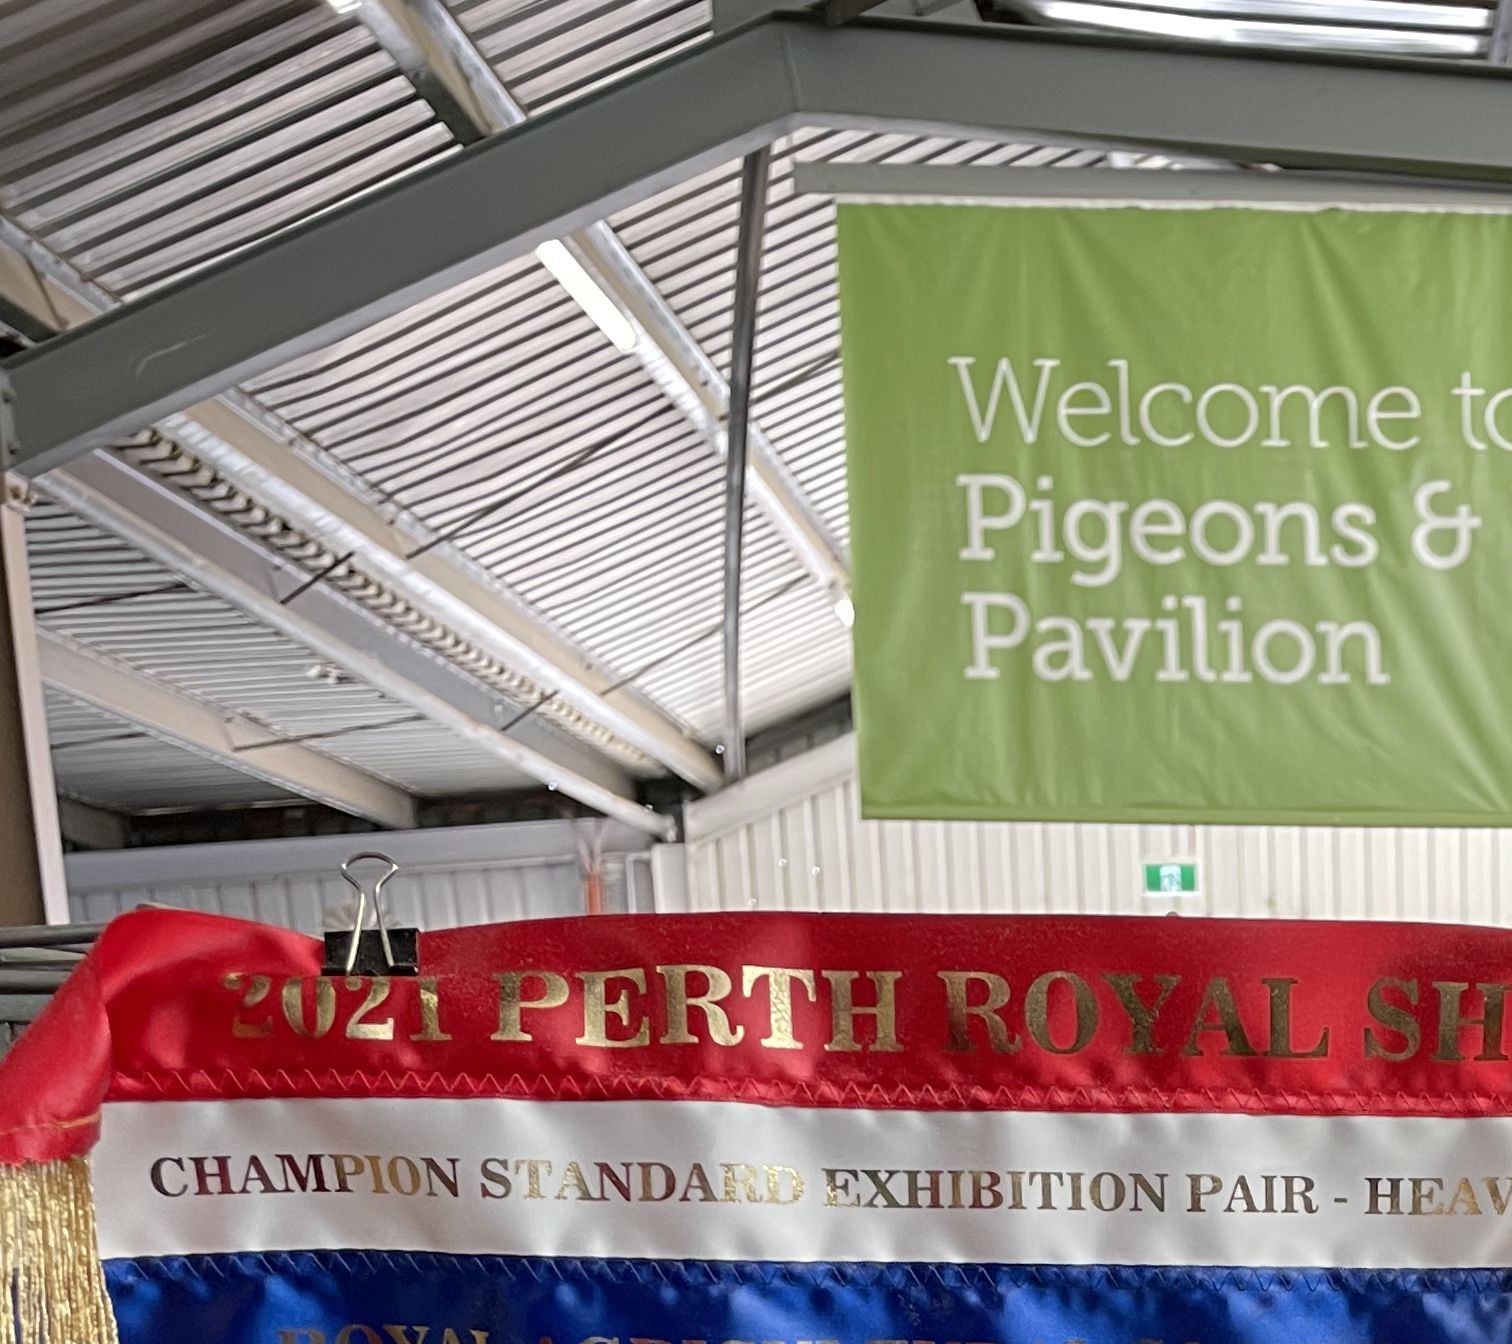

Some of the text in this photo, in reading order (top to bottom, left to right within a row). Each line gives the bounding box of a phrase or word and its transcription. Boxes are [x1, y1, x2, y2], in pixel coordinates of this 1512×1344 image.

[947, 355, 1422, 449] Welcome
[955, 473, 1381, 588] Pigeons
[1410, 480, 1483, 572] &
[960, 591, 1391, 687] Pavilion
[221, 971, 453, 1041] 2021
[489, 963, 906, 1053] PERTH
[938, 969, 1332, 1060] ROYAL
[149, 1151, 460, 1198] CHAMPION
[480, 1156, 806, 1207] STANDARD
[822, 1167, 1169, 1213] EXHIBITION
[1186, 1171, 1320, 1216] PAIR
